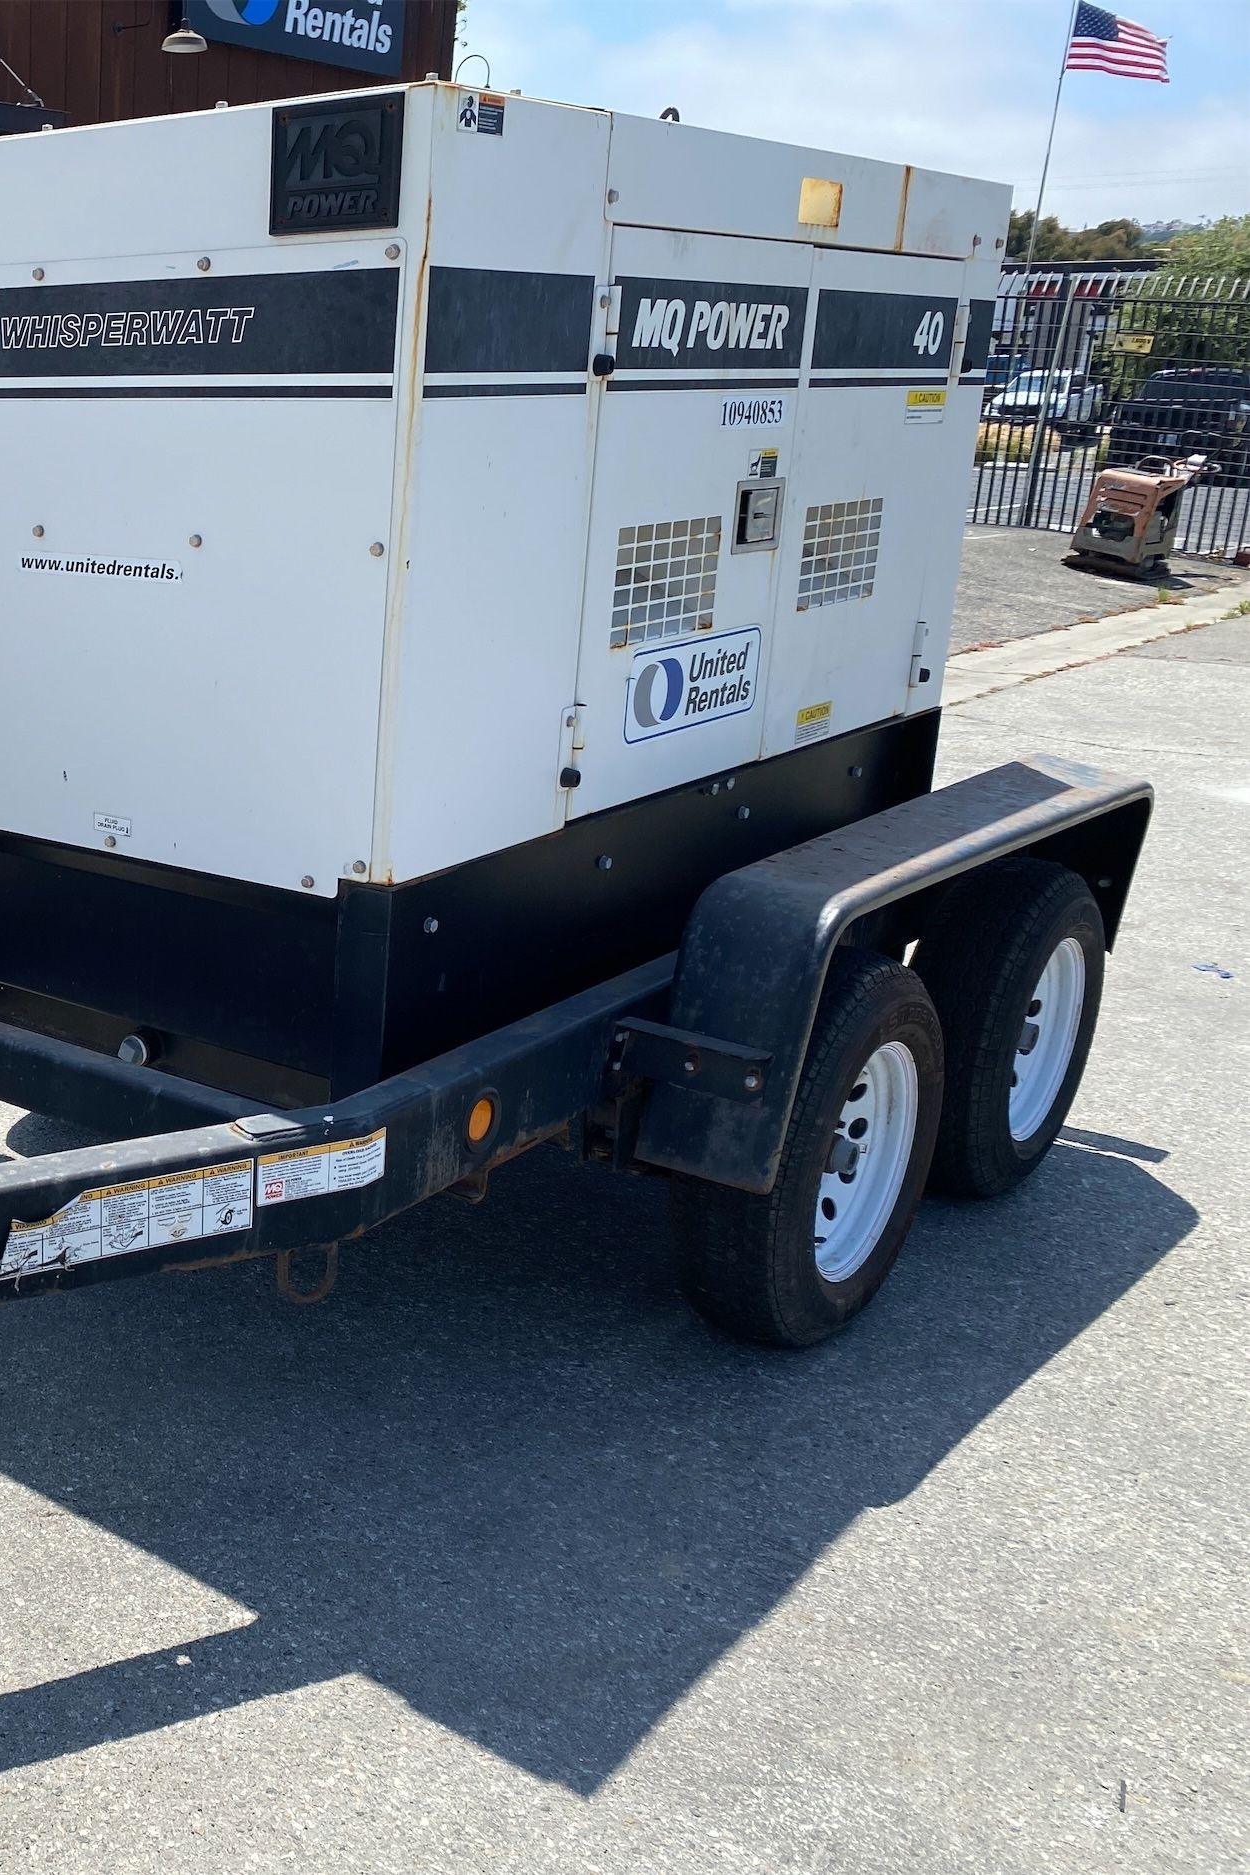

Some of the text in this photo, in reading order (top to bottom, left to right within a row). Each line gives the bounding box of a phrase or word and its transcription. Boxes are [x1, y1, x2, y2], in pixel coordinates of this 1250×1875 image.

[285, 0, 392, 53] Rentals
[287, 189, 379, 220] POWER
[0, 307, 254, 350] WHISPERWATT
[632, 298, 790, 357] MQ POWER
[913, 310, 945, 355] 40
[918, 392, 942, 403] CAUTION
[720, 400, 783, 427] 10940853
[21, 557, 183, 580] www.unitedrentals.
[689, 641, 750, 683] United
[684, 674, 751, 716] Rentals
[805, 705, 830, 721] CAUTION
[112, 824, 125, 832] PLUG
[277, 1150, 309, 1161] IMPORTANT
[165, 1172, 197, 1184] WARNING
[216, 1163, 248, 1174] WARNING
[113, 1183, 146, 1195] WARNING
[15, 1219, 48, 1230] WARNING
